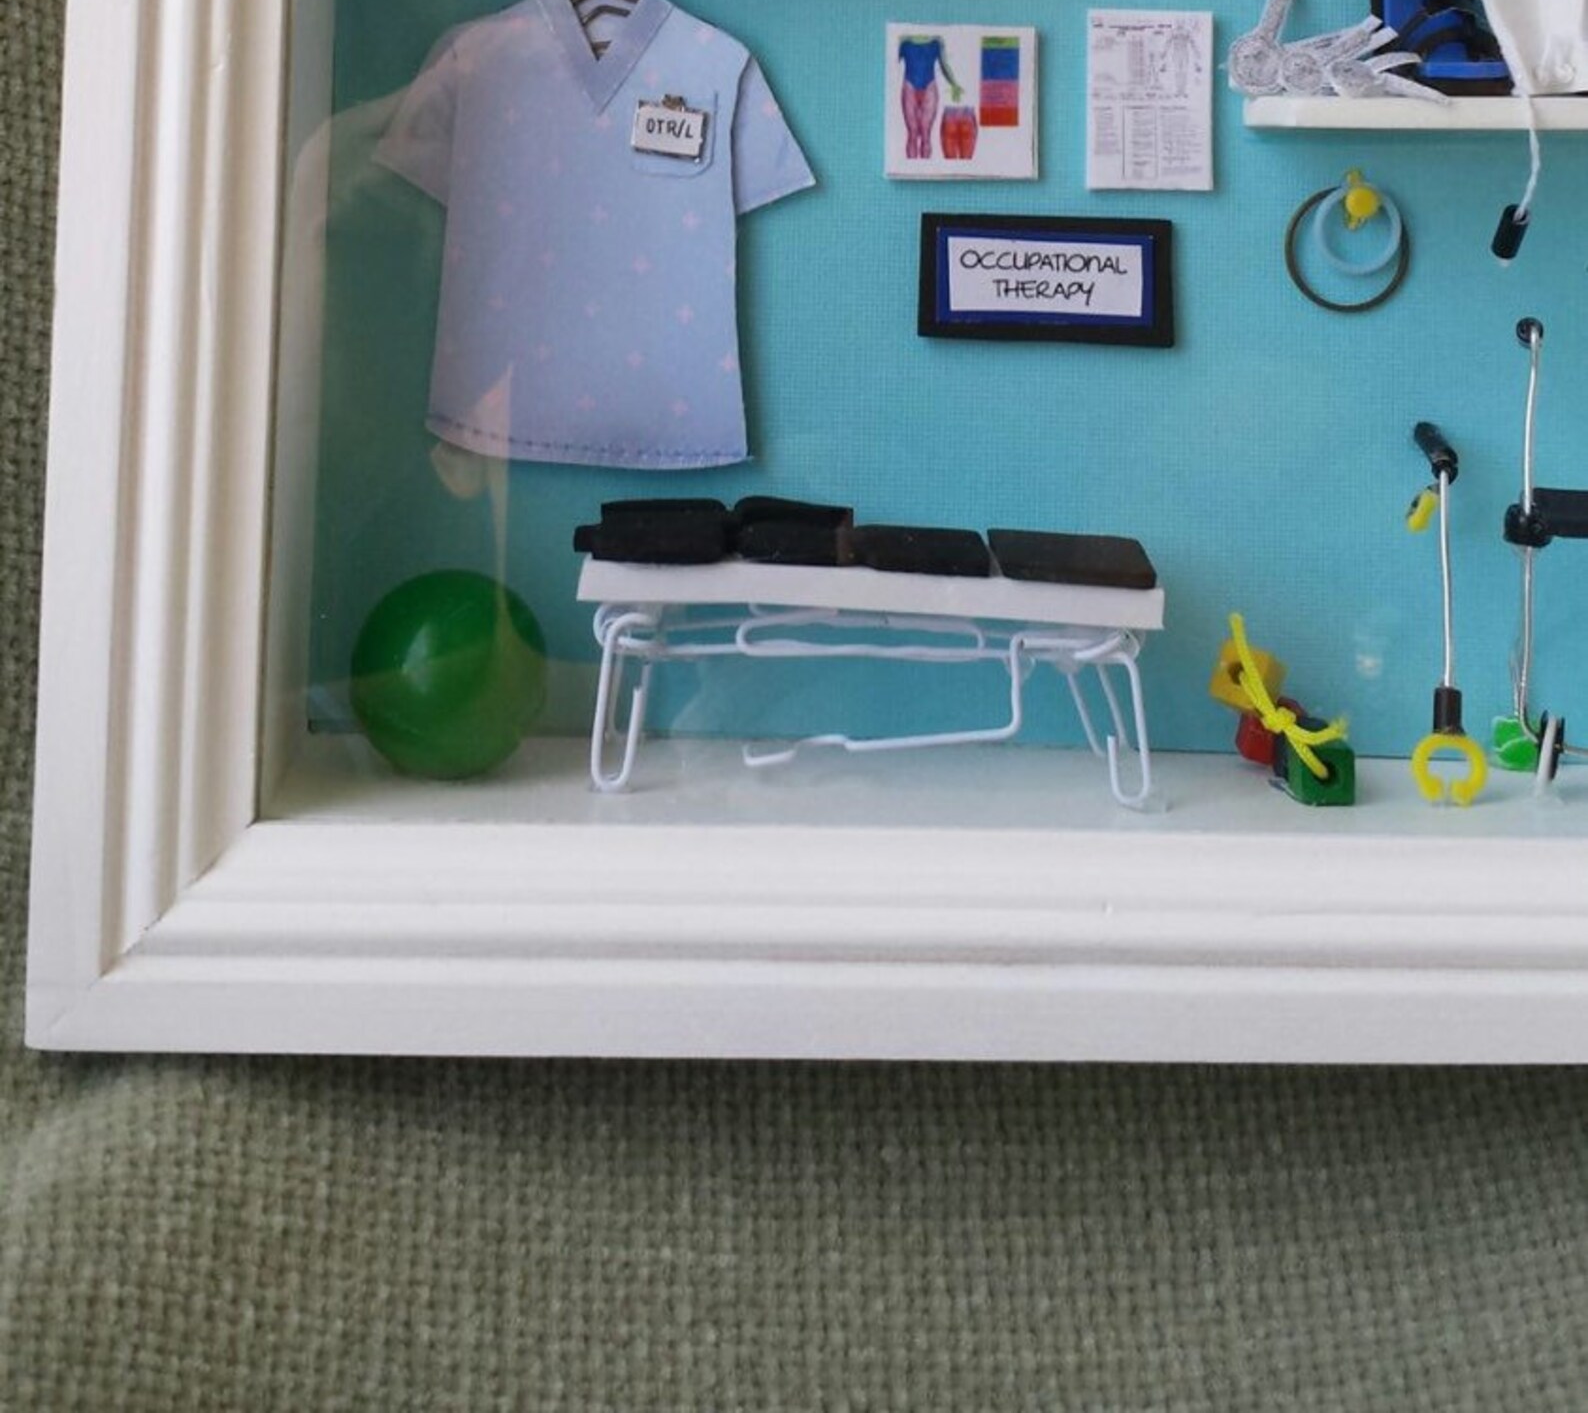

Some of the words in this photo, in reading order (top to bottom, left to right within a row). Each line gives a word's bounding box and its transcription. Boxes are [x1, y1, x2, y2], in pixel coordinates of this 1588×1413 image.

[645, 117, 694, 139] OTR/L
[959, 249, 1128, 275] OCCUPATIONAL
[992, 278, 1096, 307] THERAPY
